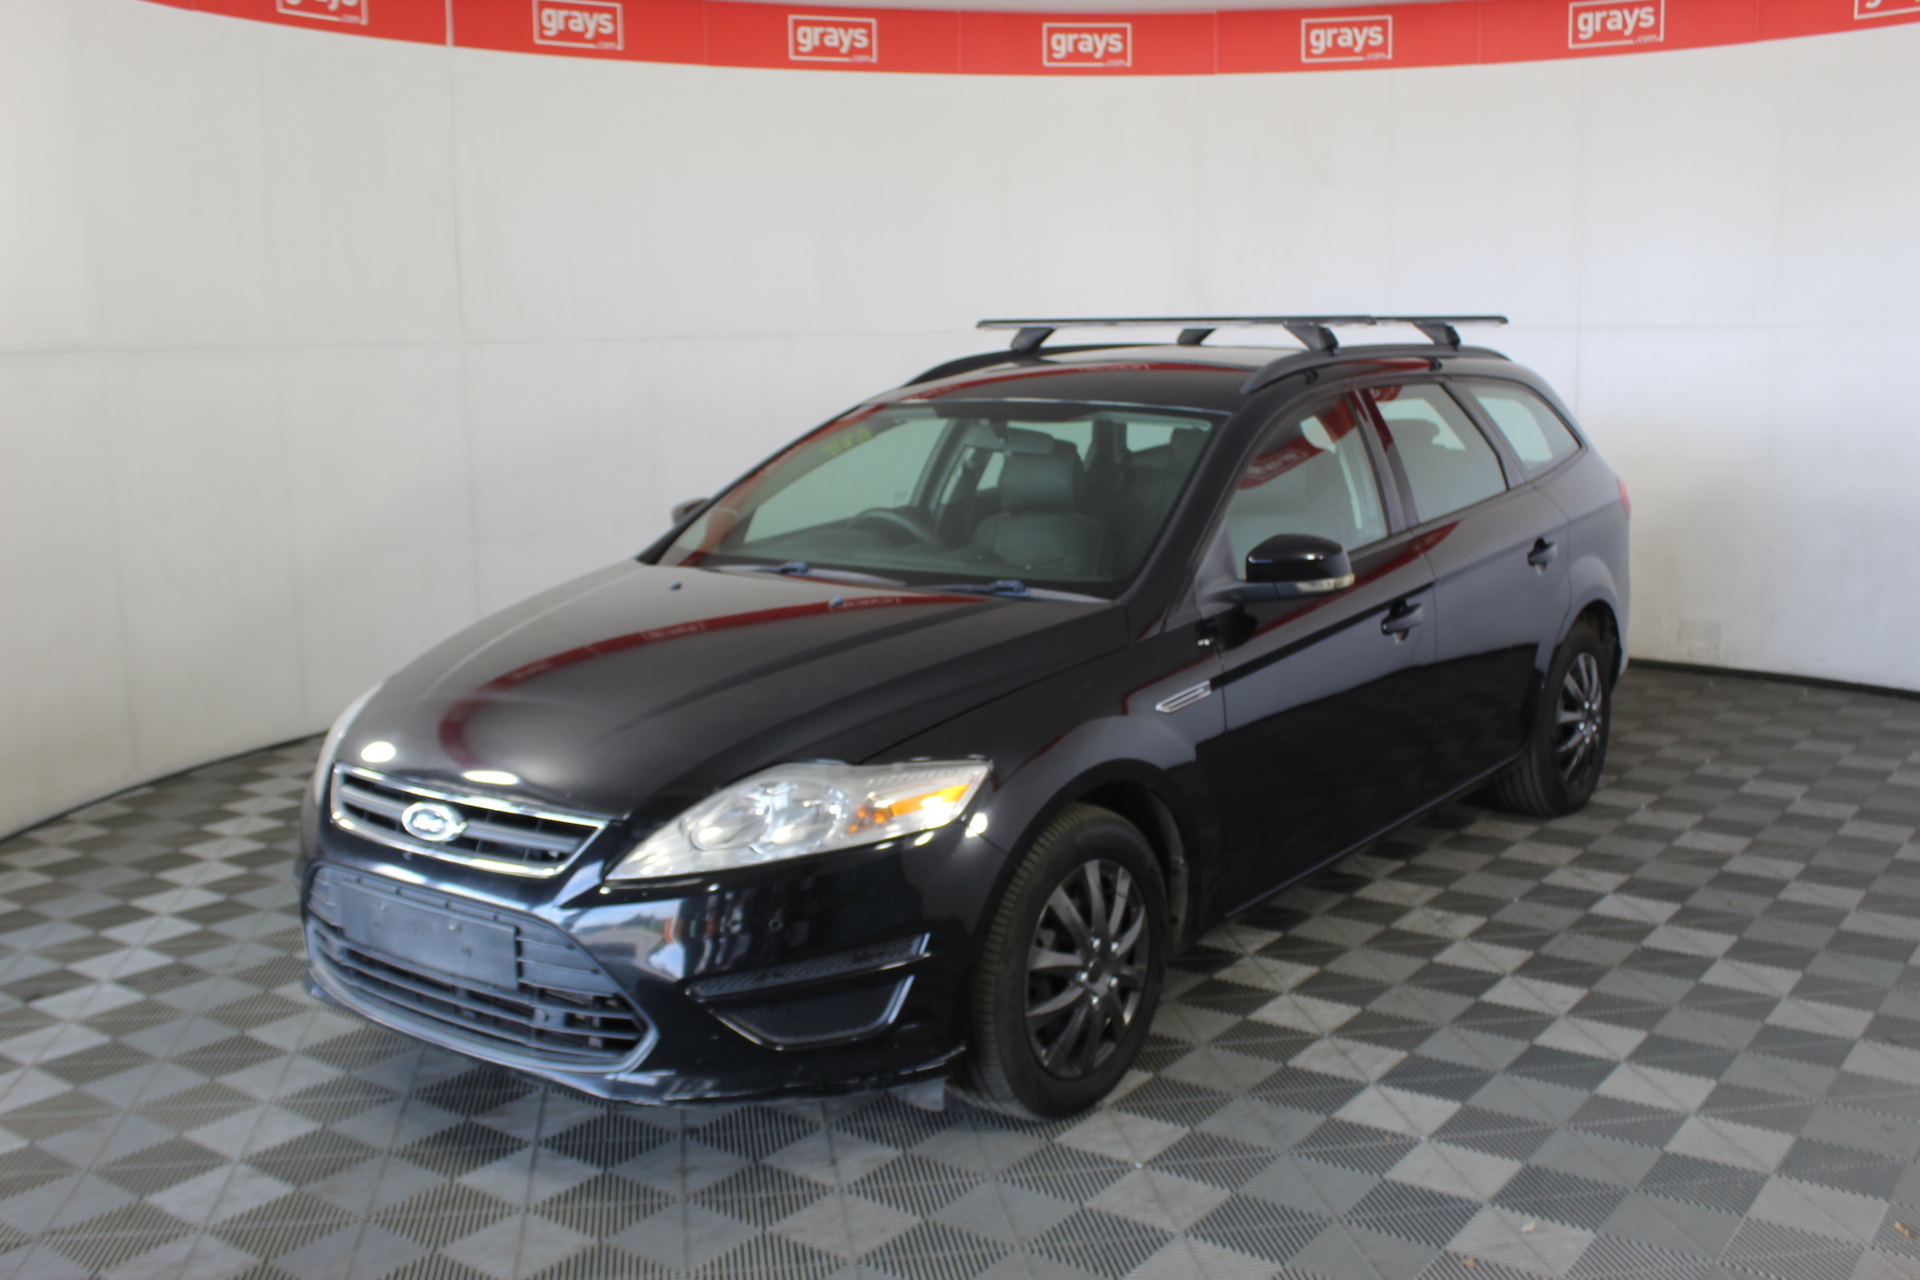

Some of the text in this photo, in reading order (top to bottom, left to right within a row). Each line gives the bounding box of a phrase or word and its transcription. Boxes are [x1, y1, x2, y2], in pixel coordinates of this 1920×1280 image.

[541, 8, 615, 39] grays
[1577, 6, 1655, 40] grays
[797, 25, 869, 54] grays
[1050, 32, 1123, 59] grays
[1309, 26, 1384, 55] grays
